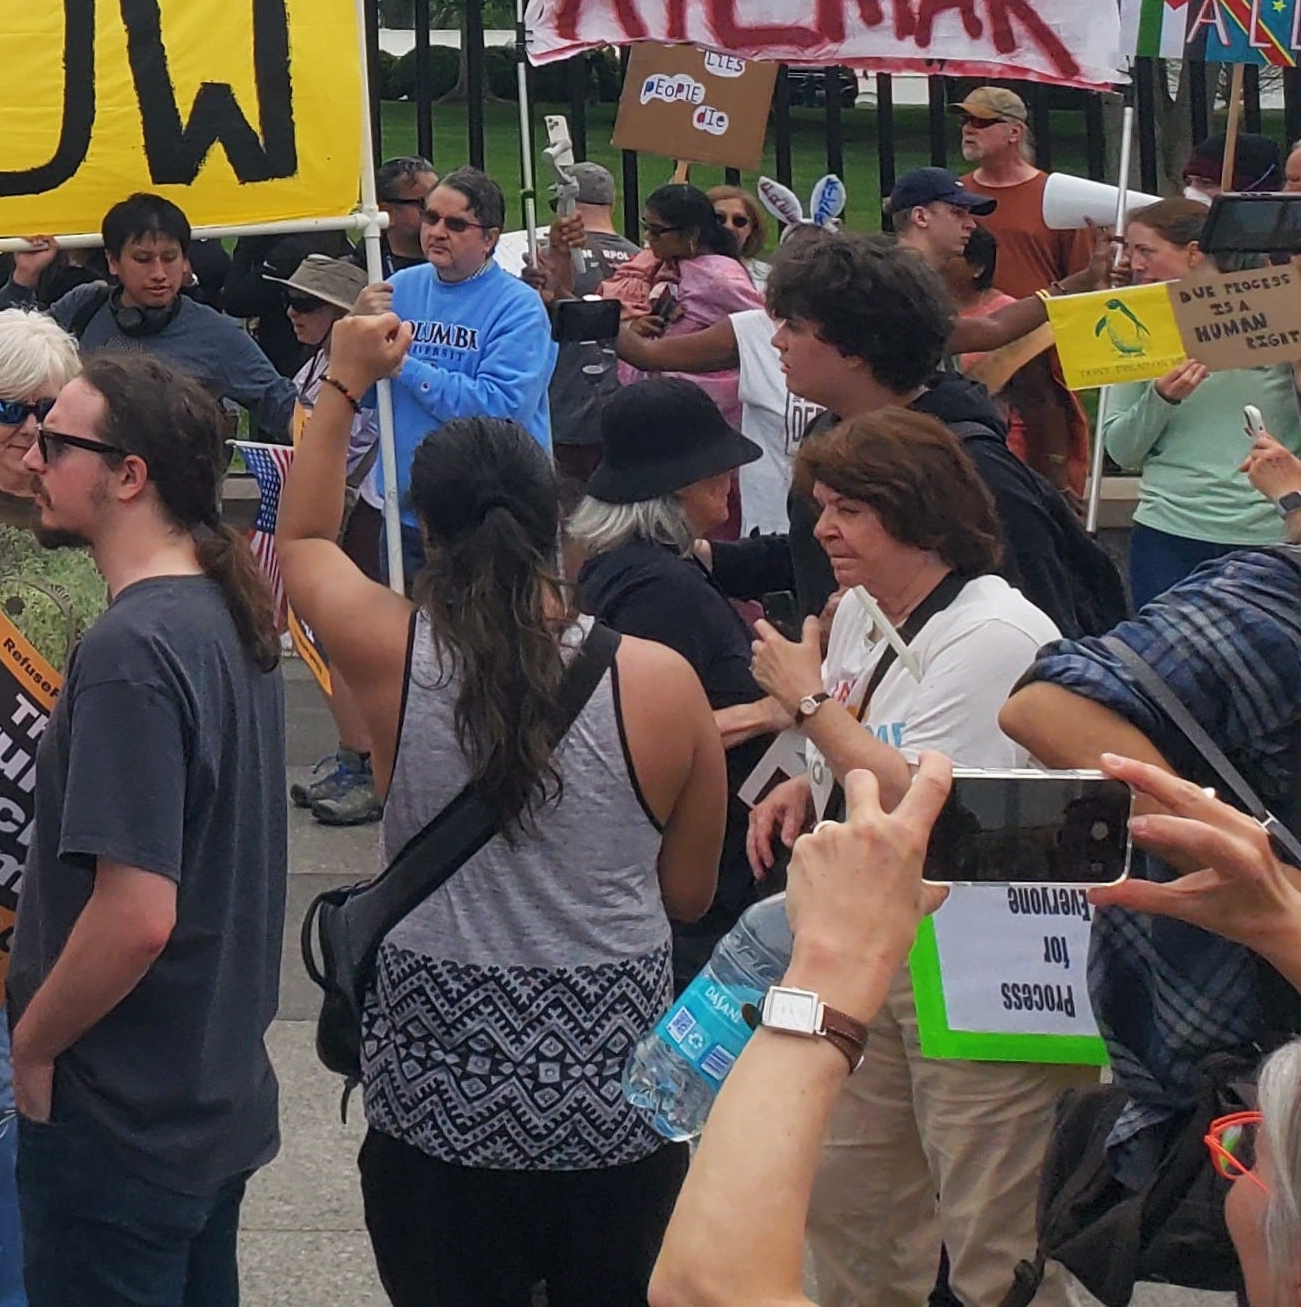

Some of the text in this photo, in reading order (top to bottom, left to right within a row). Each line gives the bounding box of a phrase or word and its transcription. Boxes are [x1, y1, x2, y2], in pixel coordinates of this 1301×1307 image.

[1179, 273, 1290, 304] DUE PROCESS
[1209, 299, 1251, 315] IS A
[1194, 312, 1267, 343] HUMAN
[1245, 330, 1300, 349] RIGHT
[11, 693, 49, 739] Th
[1007, 886, 1091, 921] Everyone
[1044, 935, 1070, 969] for
[705, 985, 740, 1023] DASAN
[1001, 982, 1076, 1018] Process
